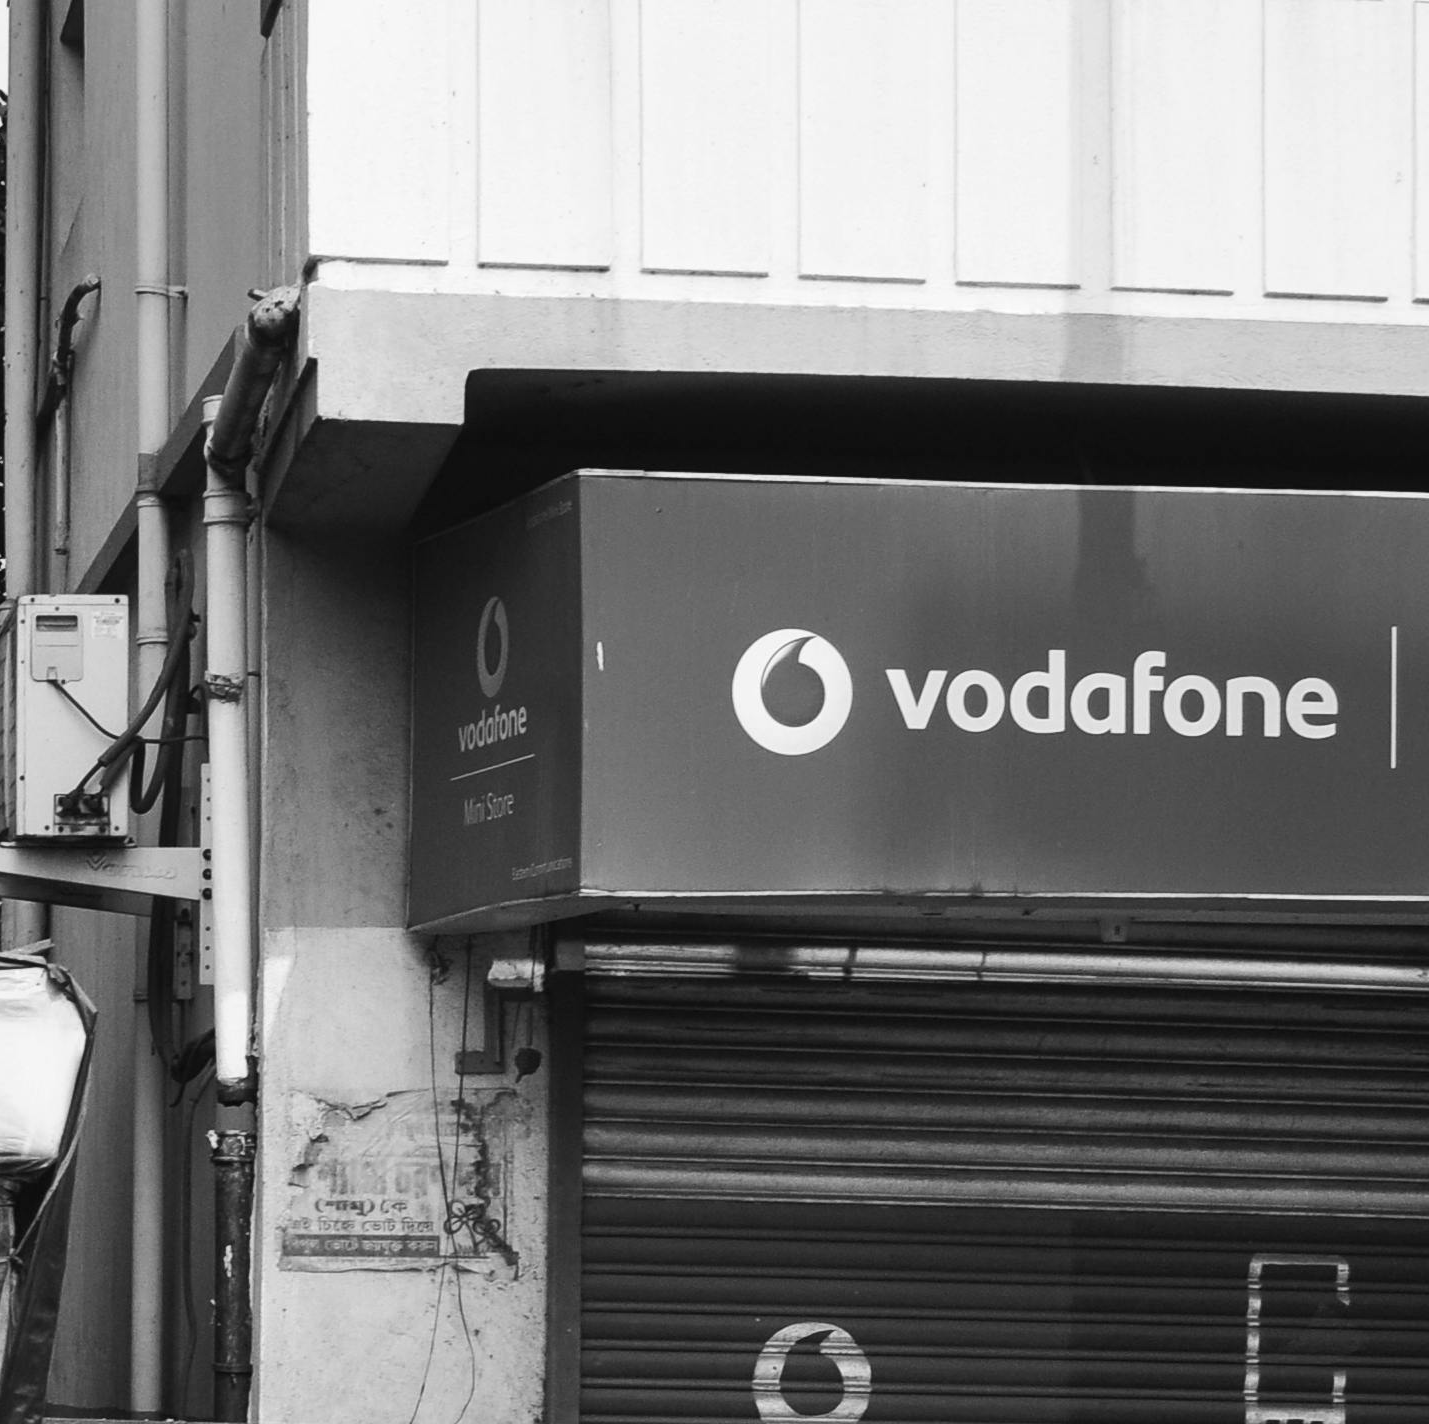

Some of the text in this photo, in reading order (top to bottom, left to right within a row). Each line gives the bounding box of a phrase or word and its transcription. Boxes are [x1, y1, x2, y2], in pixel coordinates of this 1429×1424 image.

[885, 649, 1339, 739] vodafone
[457, 703, 528, 752] vodafone
[463, 791, 515, 826] Mini Store
[380, 1199, 408, 1213] কে
[362, 1217, 397, 1232] ভোট
